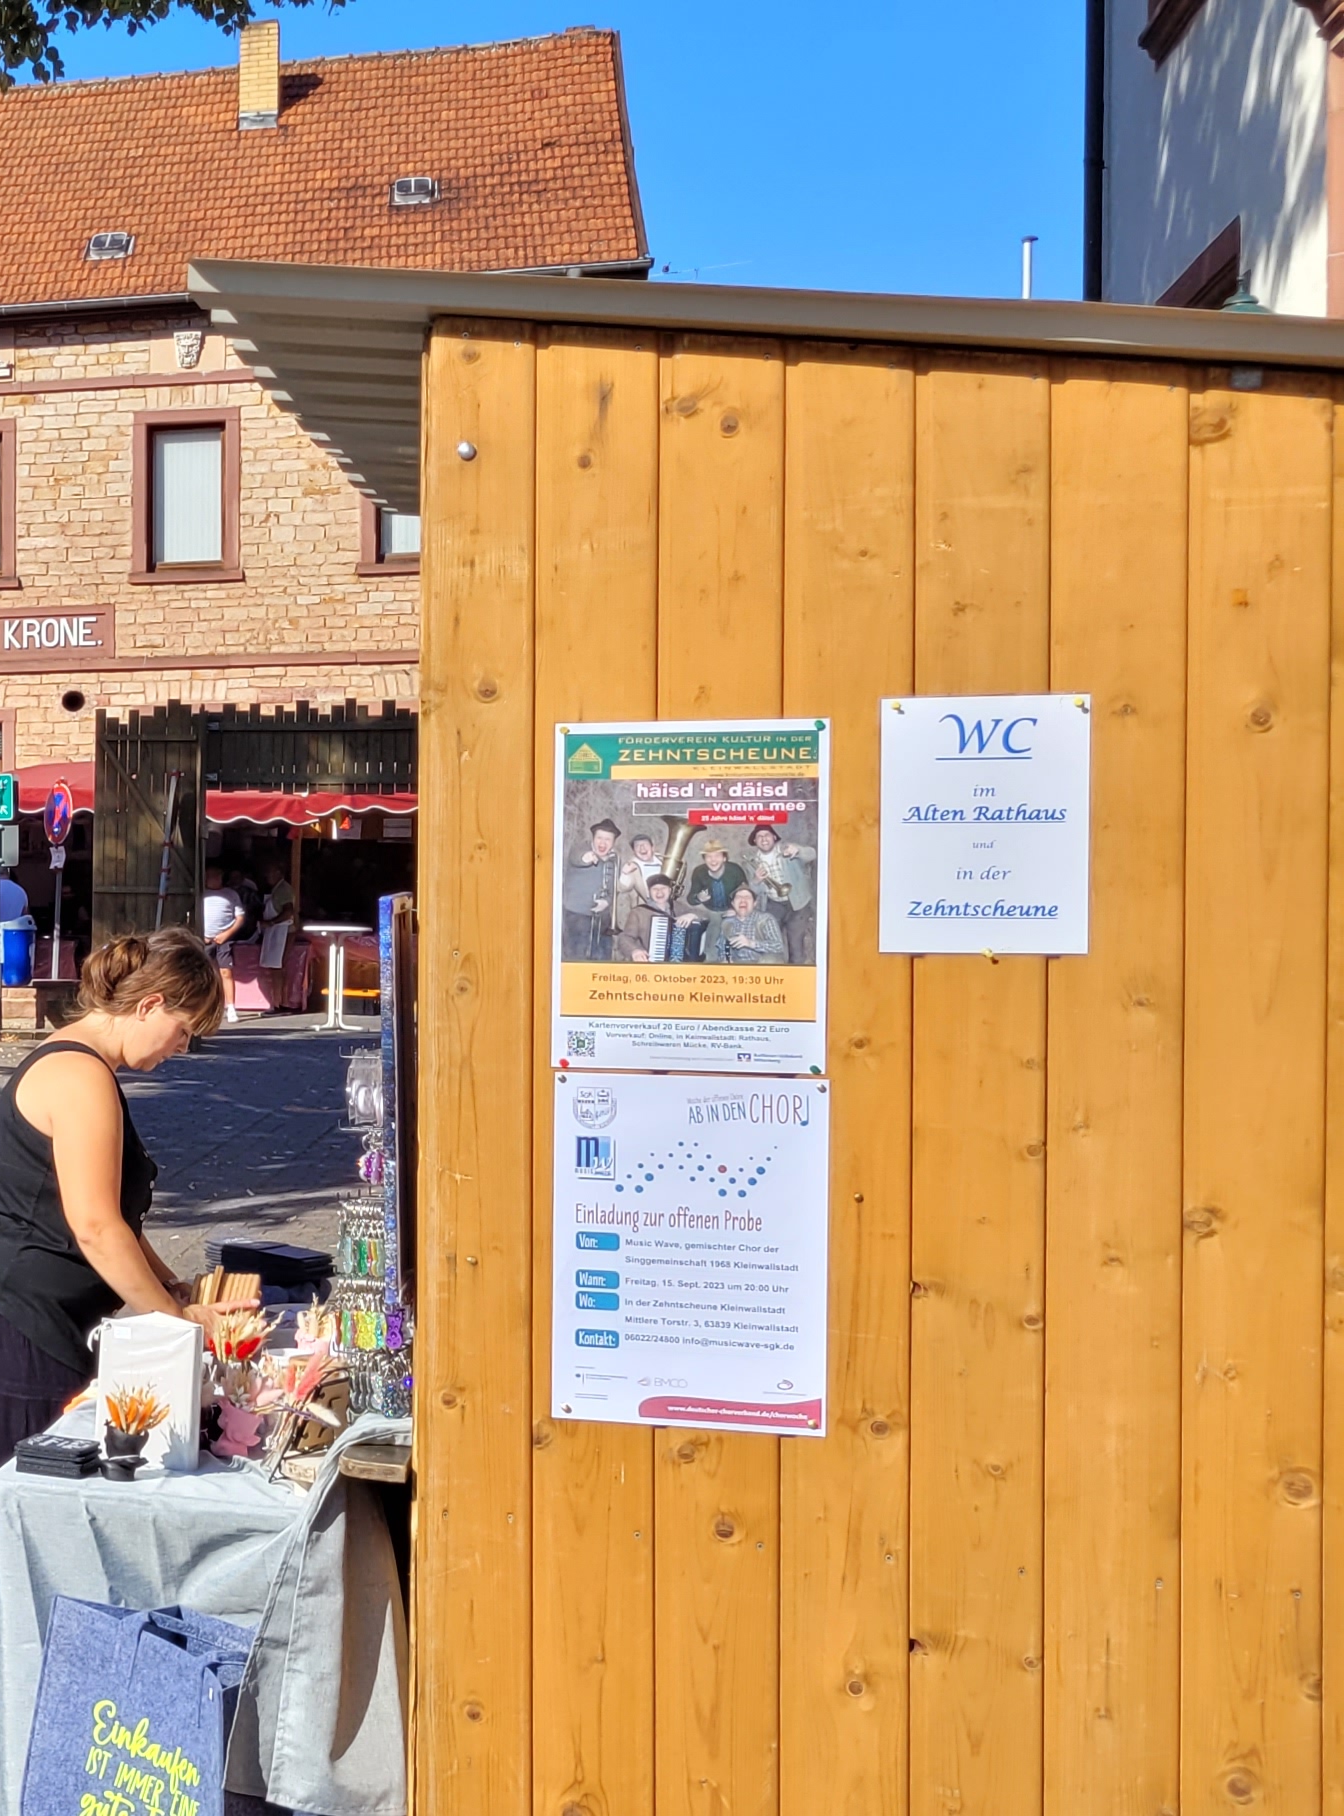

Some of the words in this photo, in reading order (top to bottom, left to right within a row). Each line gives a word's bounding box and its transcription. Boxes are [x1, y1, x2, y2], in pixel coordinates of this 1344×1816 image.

[3, 616, 103, 650] KRONE.
[618, 735, 717, 745] FÖRDERVEREIN
[722, 735, 771, 743] KULTUR
[938, 713, 1038, 755] WC
[618, 747, 812, 762] ZEHNTSCHEUNE
[636, 782, 693, 798] häisd
[700, 782, 722, 798] 'n'
[728, 781, 788, 797] däisd
[972, 784, 996, 798] im
[712, 802, 764, 812] vomm
[769, 801, 806, 812] mee
[902, 804, 966, 821] Alten
[972, 803, 1067, 821] Rathaus
[972, 839, 997, 849] und
[955, 867, 973, 881] in
[980, 865, 1012, 881] der
[907, 898, 1059, 917] Zehntscheune
[591, 972, 632, 984] Freitag,
[635, 974, 650, 983] 06.
[654, 974, 697, 983] Oktober
[699, 975, 728, 985] 2023,
[732, 975, 761, 985] 19:30
[764, 976, 784, 985] Uhr
[588, 989, 685, 1002] Zehntscheune
[689, 991, 786, 1004] Kleinwallstadt
[588, 1021, 660, 1030] Kartenvorverkauf
[662, 1023, 672, 1031] 20
[675, 1023, 695, 1031] Euro
[702, 1024, 755, 1032] Abendkasse
[769, 1025, 790, 1033] Euro
[688, 1105, 704, 1125] AB
[706, 1103, 720, 1123] IN
[722, 1101, 747, 1121] DEN
[575, 1202, 639, 1233] Einladung
[643, 1211, 665, 1227] zur
[668, 1206, 719, 1230] offenen
[724, 1209, 762, 1232] Probe
[578, 1233, 598, 1248] Von:
[625, 1238, 652, 1247] Music
[654, 1240, 682, 1250] Wave,
[684, 1242, 736, 1252] gemischter
[738, 1244, 761, 1252] Chor
[763, 1245, 779, 1253] der
[625, 1256, 707, 1267] Singgemeinschaft
[733, 1261, 799, 1272] Kleinwallstadt
[578, 1271, 606, 1286] Wann:
[662, 1279, 675, 1287] 15.
[677, 1280, 701, 1290] Sept.
[703, 1281, 725, 1290] 2023
[744, 1283, 770, 1292] 20:00
[772, 1285, 789, 1293] Uhr
[578, 1293, 596, 1308] Wo:
[635, 1299, 650, 1307] der
[652, 1299, 718, 1311] Zehntscheune
[720, 1303, 786, 1314] Kleinwallstadt
[625, 1316, 658, 1325] Mittlere
[661, 1317, 691, 1327] Torstr.
[693, 1319, 702, 1328] 3,
[733, 1322, 799, 1333] Kleinwallstadt
[578, 1330, 616, 1346] Kontakt:
[682, 1337, 795, 1351] info@musicwave-sgk.de
[92, 1699, 201, 1794] Einkaufen
[85, 1745, 113, 1780] IST
[113, 1761, 165, 1808] IMMER
